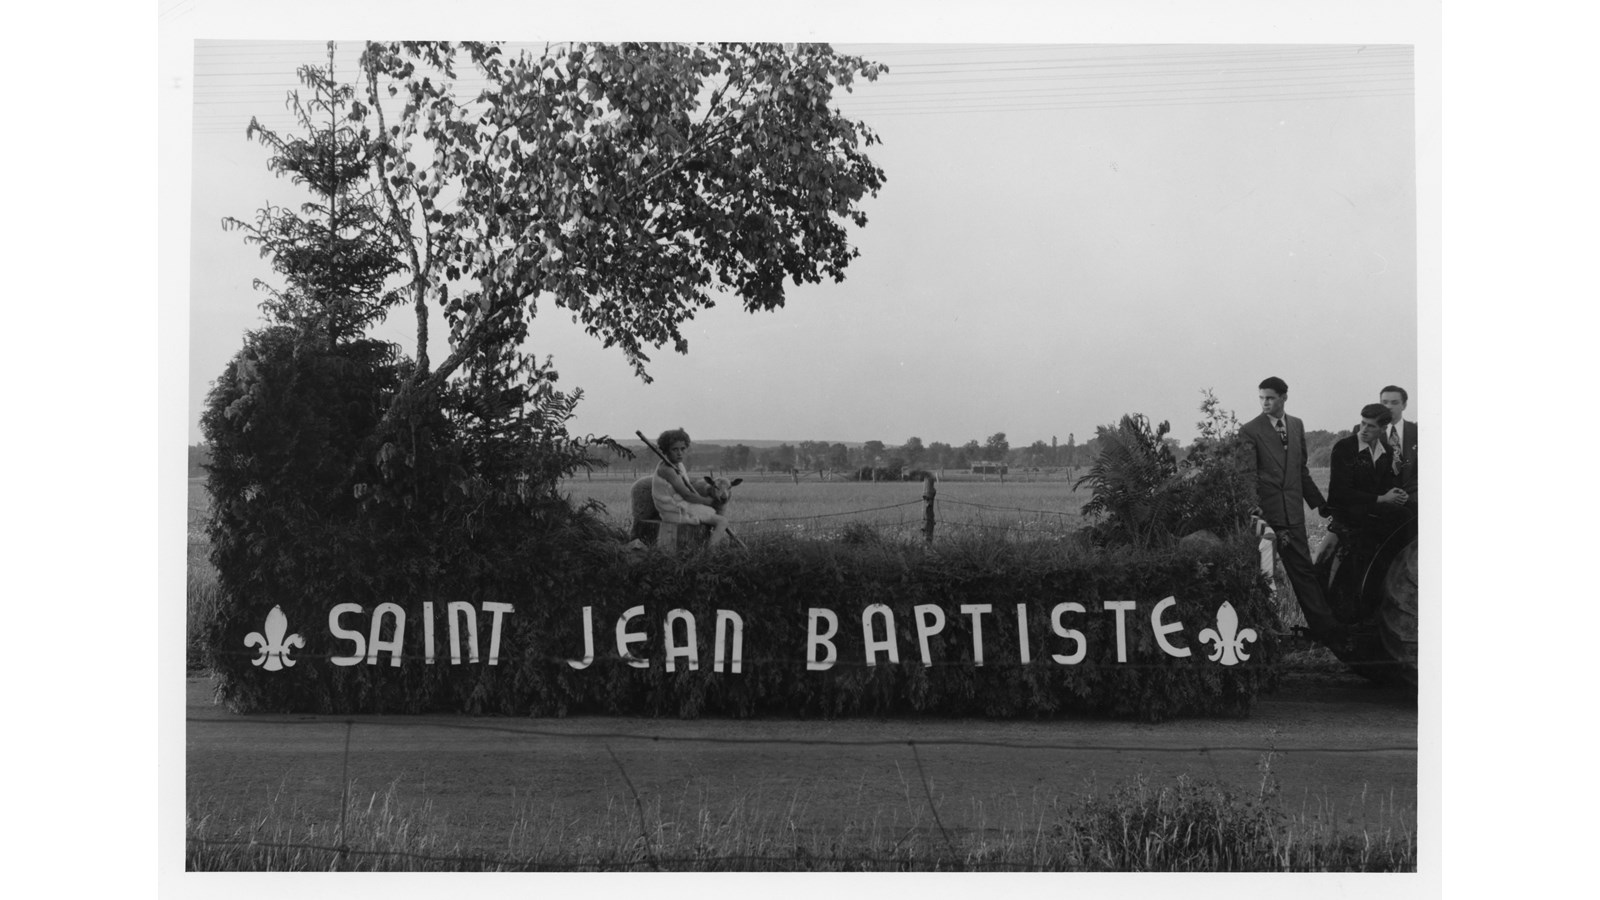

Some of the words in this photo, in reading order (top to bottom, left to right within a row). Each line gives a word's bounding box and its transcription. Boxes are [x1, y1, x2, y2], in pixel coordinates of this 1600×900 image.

[328, 601, 515, 667] SAINT
[567, 605, 744, 674] JEAN
[806, 595, 1192, 671] BAPTISTE
